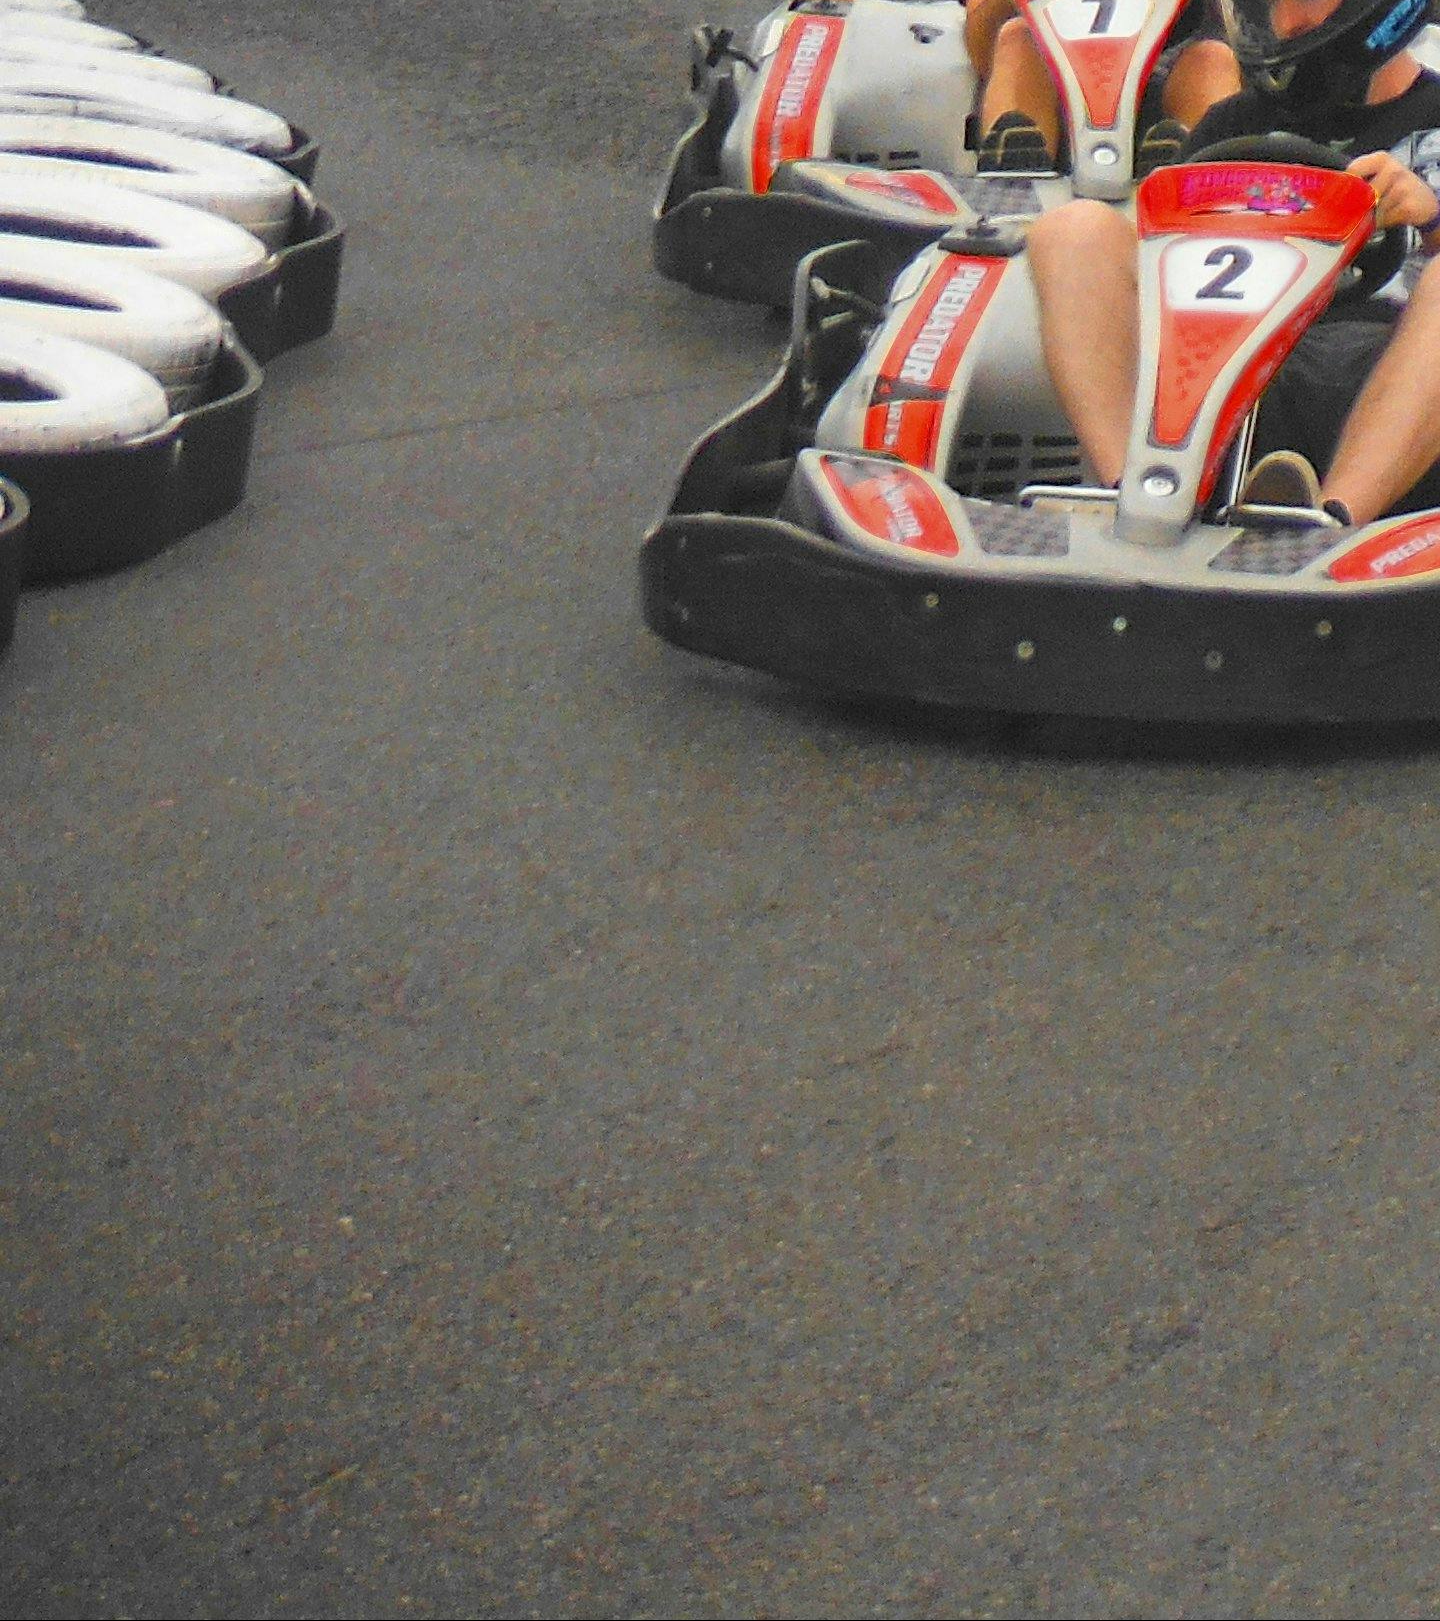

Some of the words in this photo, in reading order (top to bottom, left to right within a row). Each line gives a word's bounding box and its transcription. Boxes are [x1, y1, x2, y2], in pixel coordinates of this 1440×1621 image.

[776, 22, 829, 118] PREDATOR
[1195, 245, 1254, 300] 2
[899, 263, 988, 385] PREDATOR
